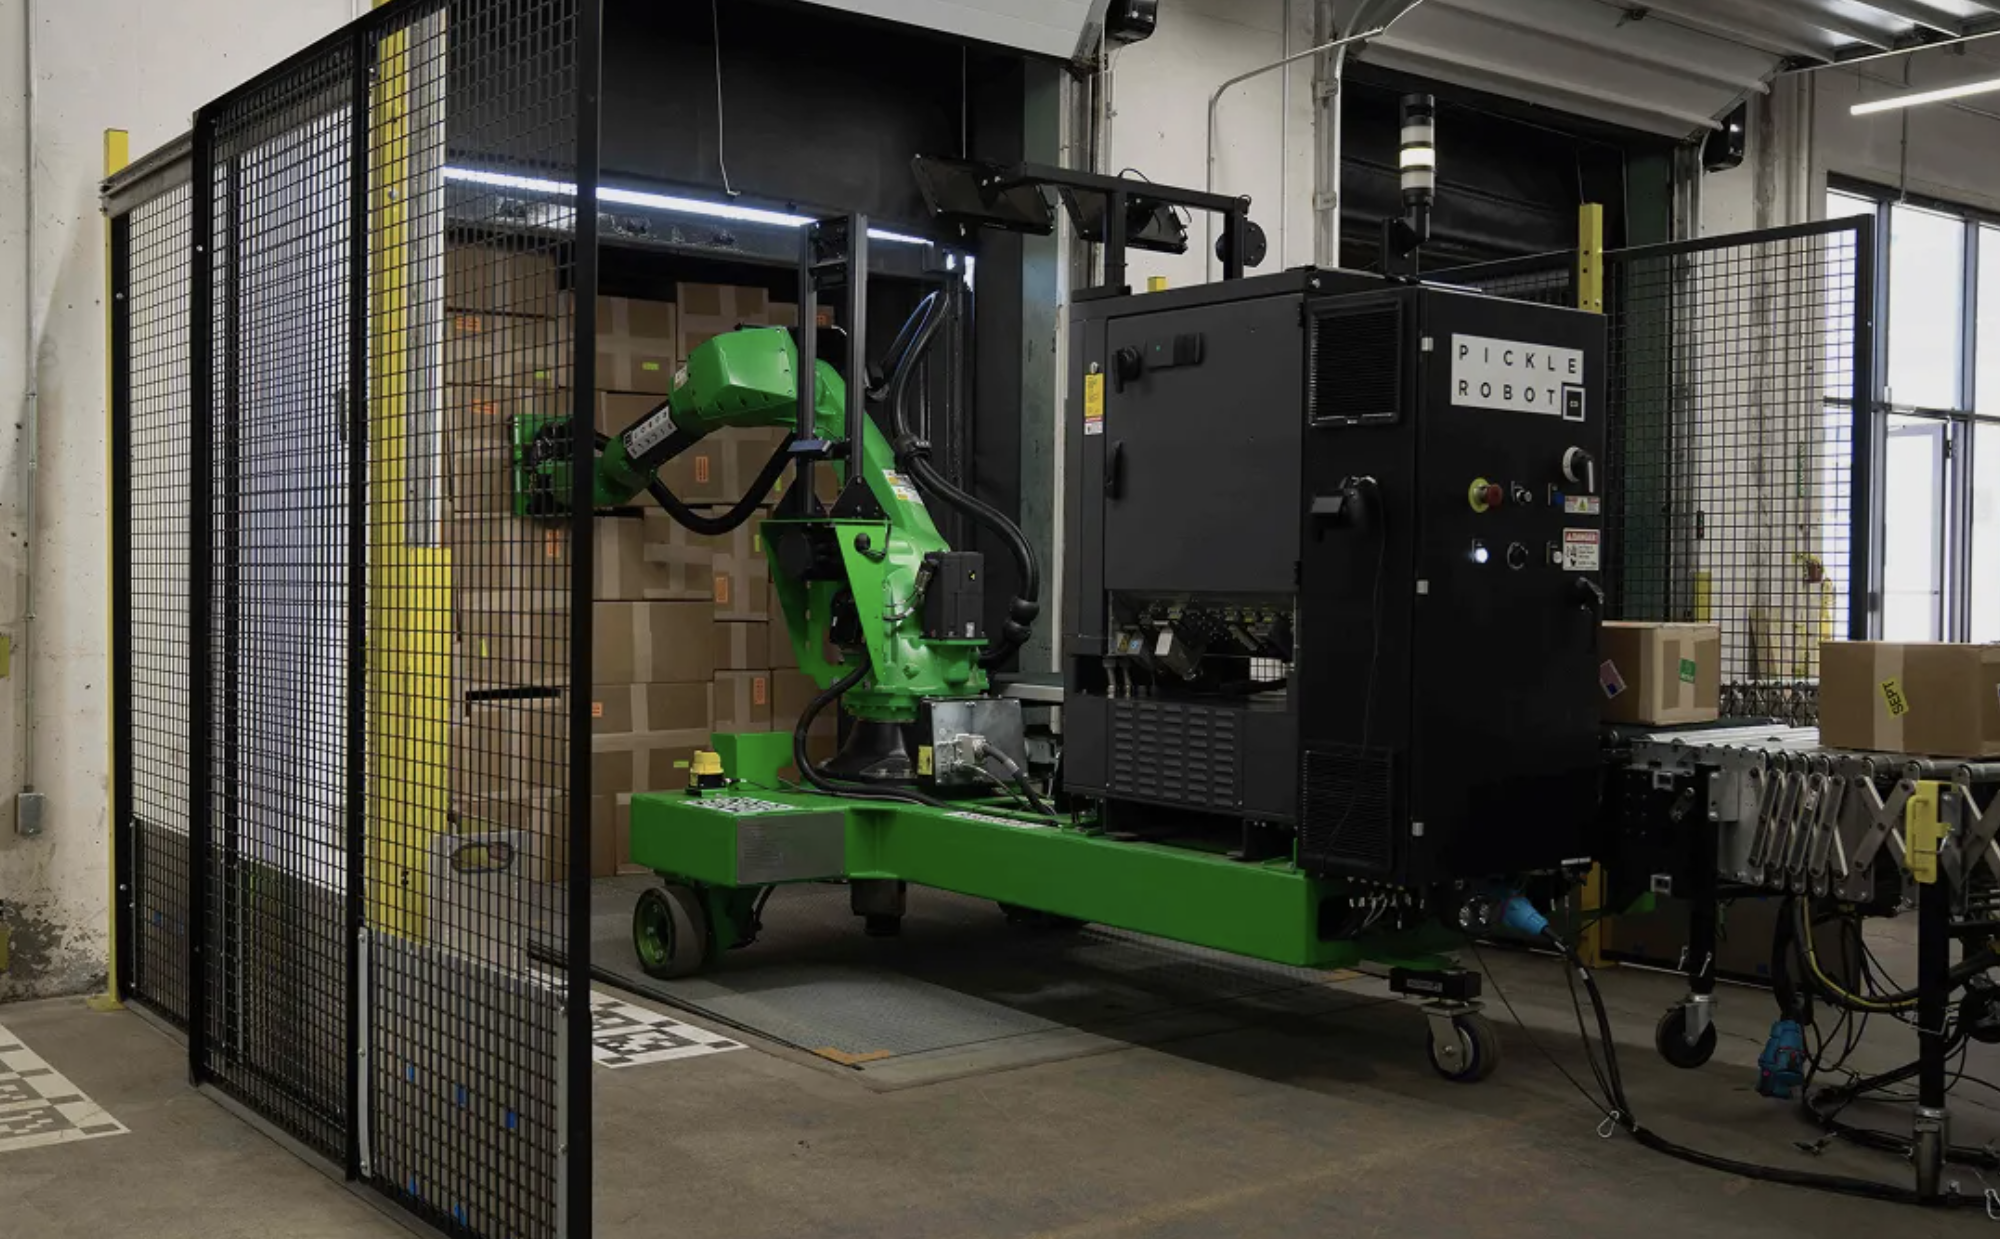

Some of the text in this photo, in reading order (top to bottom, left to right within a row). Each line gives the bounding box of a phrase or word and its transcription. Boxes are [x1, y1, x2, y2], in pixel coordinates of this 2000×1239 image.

[1459, 344, 1577, 374] PICKLE
[1459, 379, 1556, 405] ROBOT
[1882, 681, 1904, 715] SEPT
